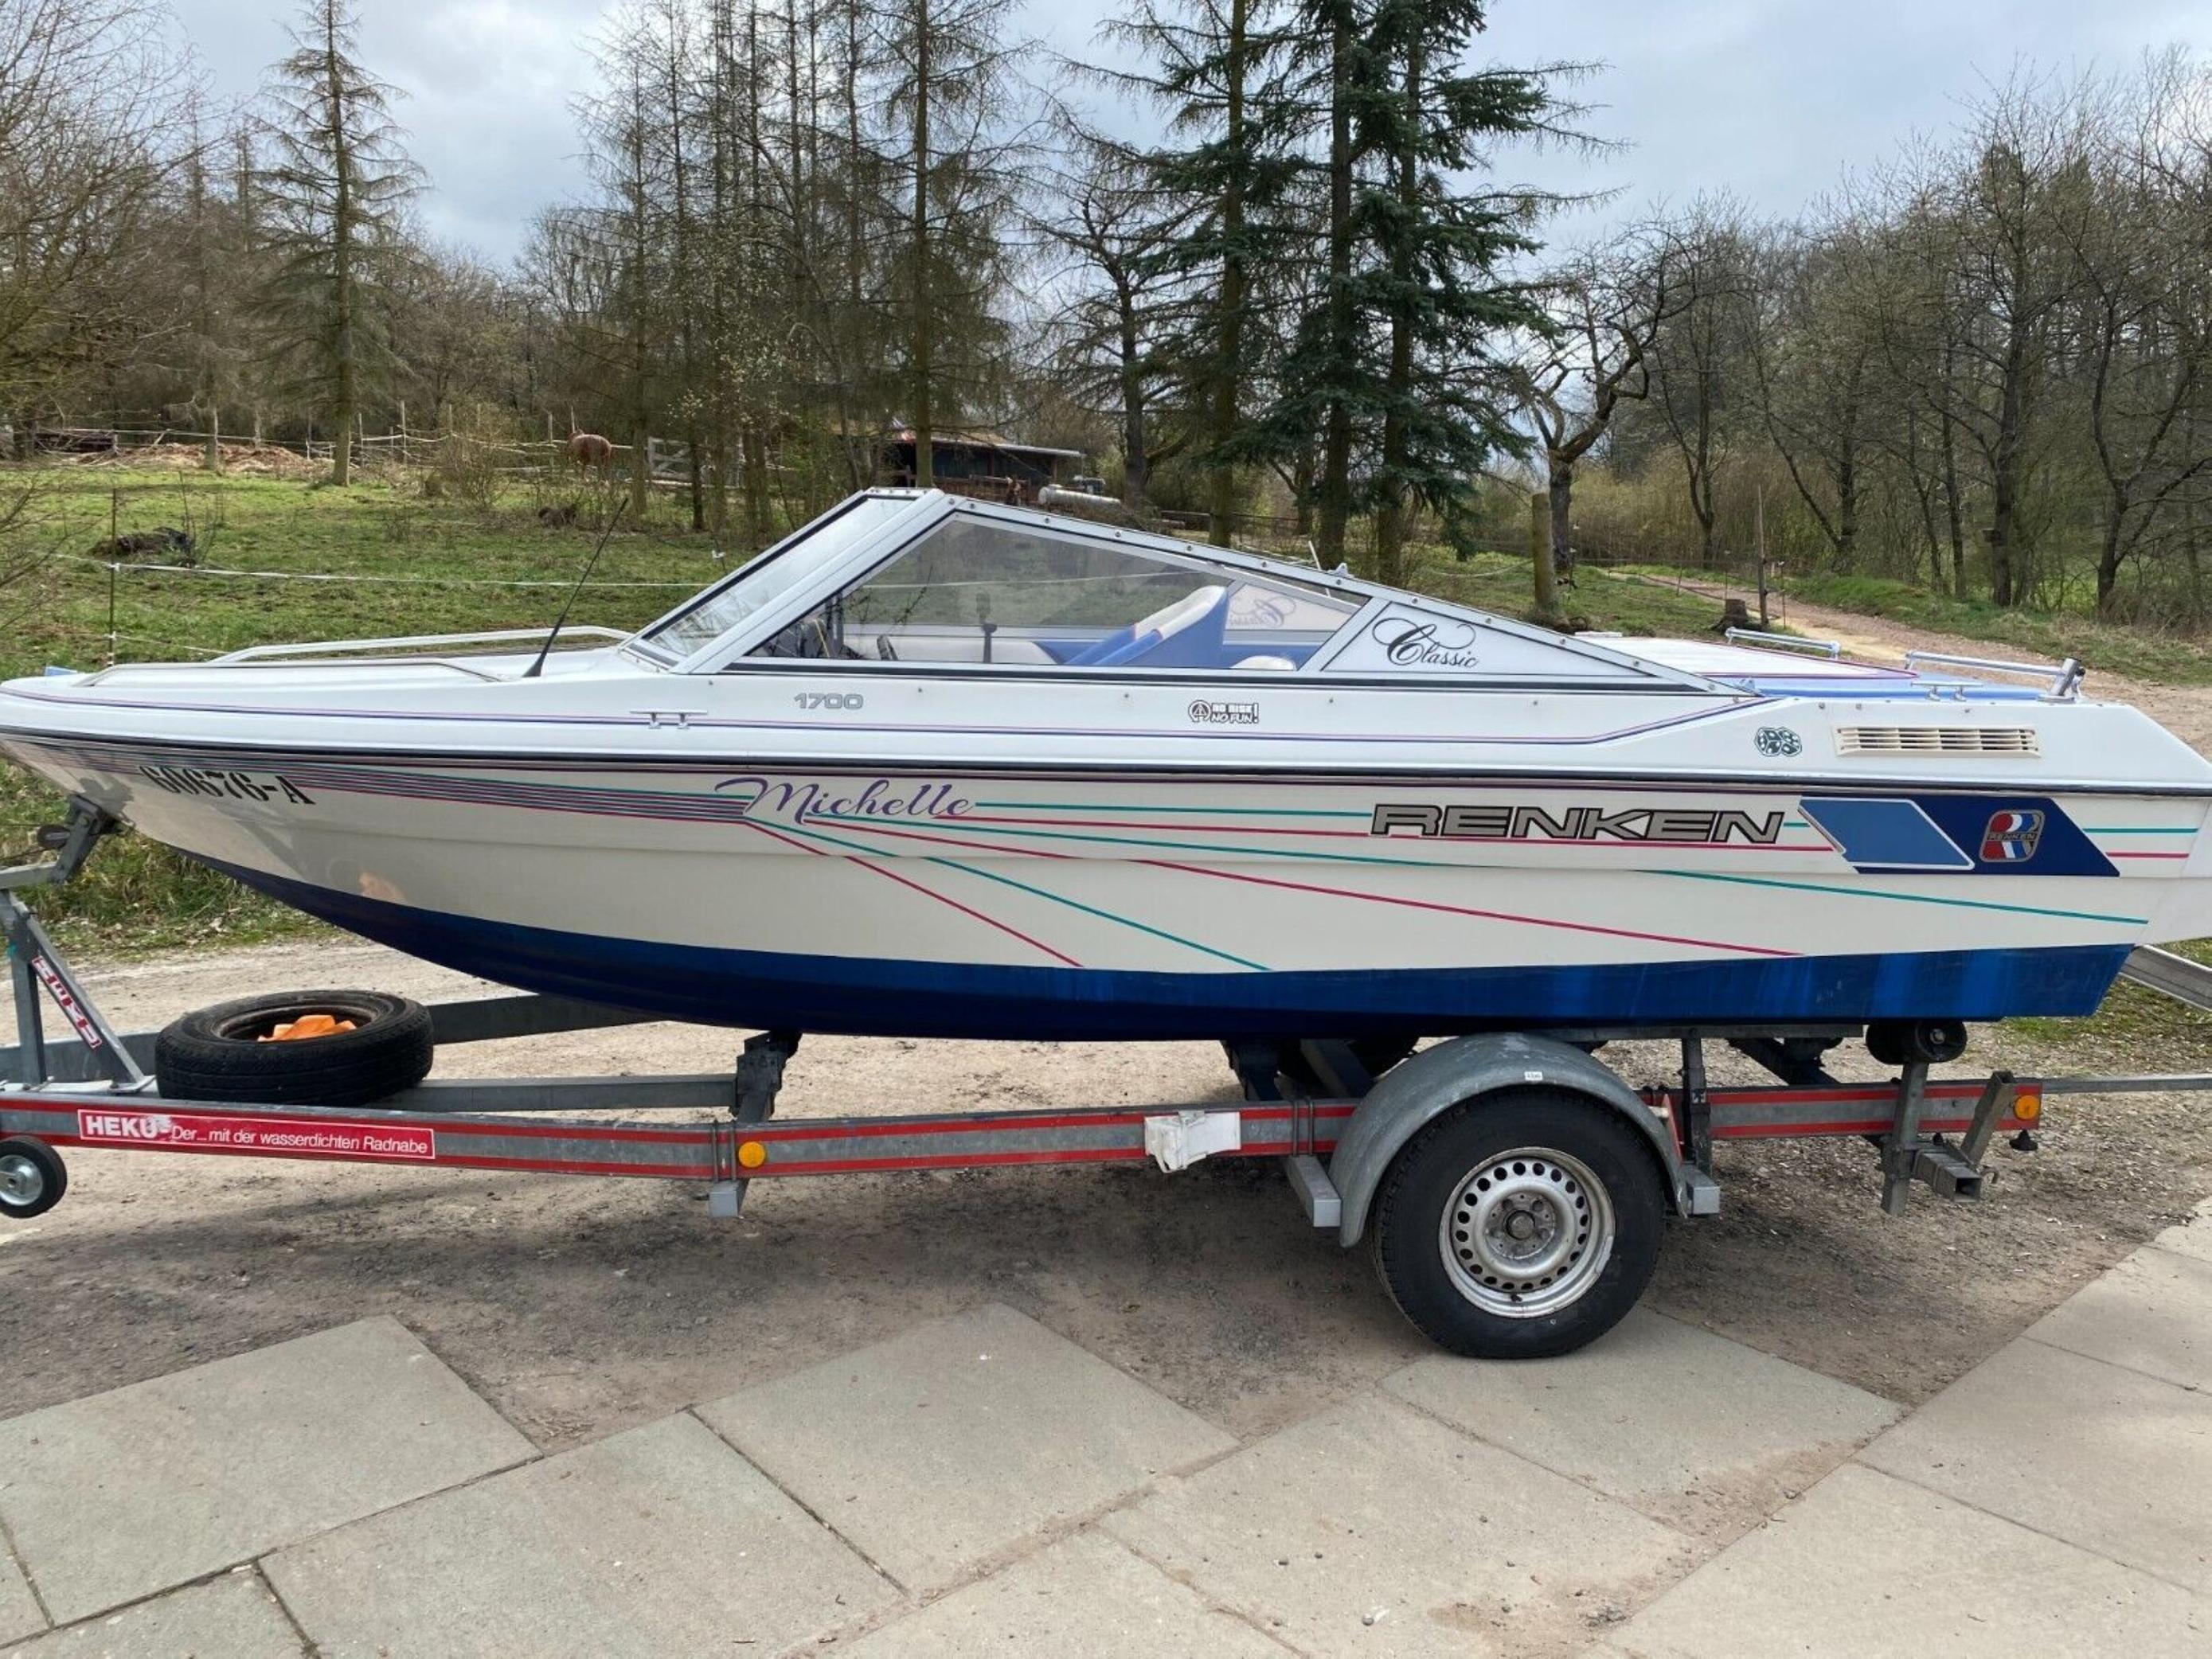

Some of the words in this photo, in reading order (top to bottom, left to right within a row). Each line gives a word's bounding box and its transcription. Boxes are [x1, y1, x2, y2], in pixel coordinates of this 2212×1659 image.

[1372, 618, 1479, 667] Classic
[794, 693, 864, 710] 1700
[1210, 712, 1229, 724] NO
[714, 777, 973, 826] Michelle
[1370, 804, 1784, 844] RENKEN
[233, 1129, 256, 1144] der
[260, 1130, 359, 1150] wasserdichten
[363, 1136, 428, 1153] Radnabe
